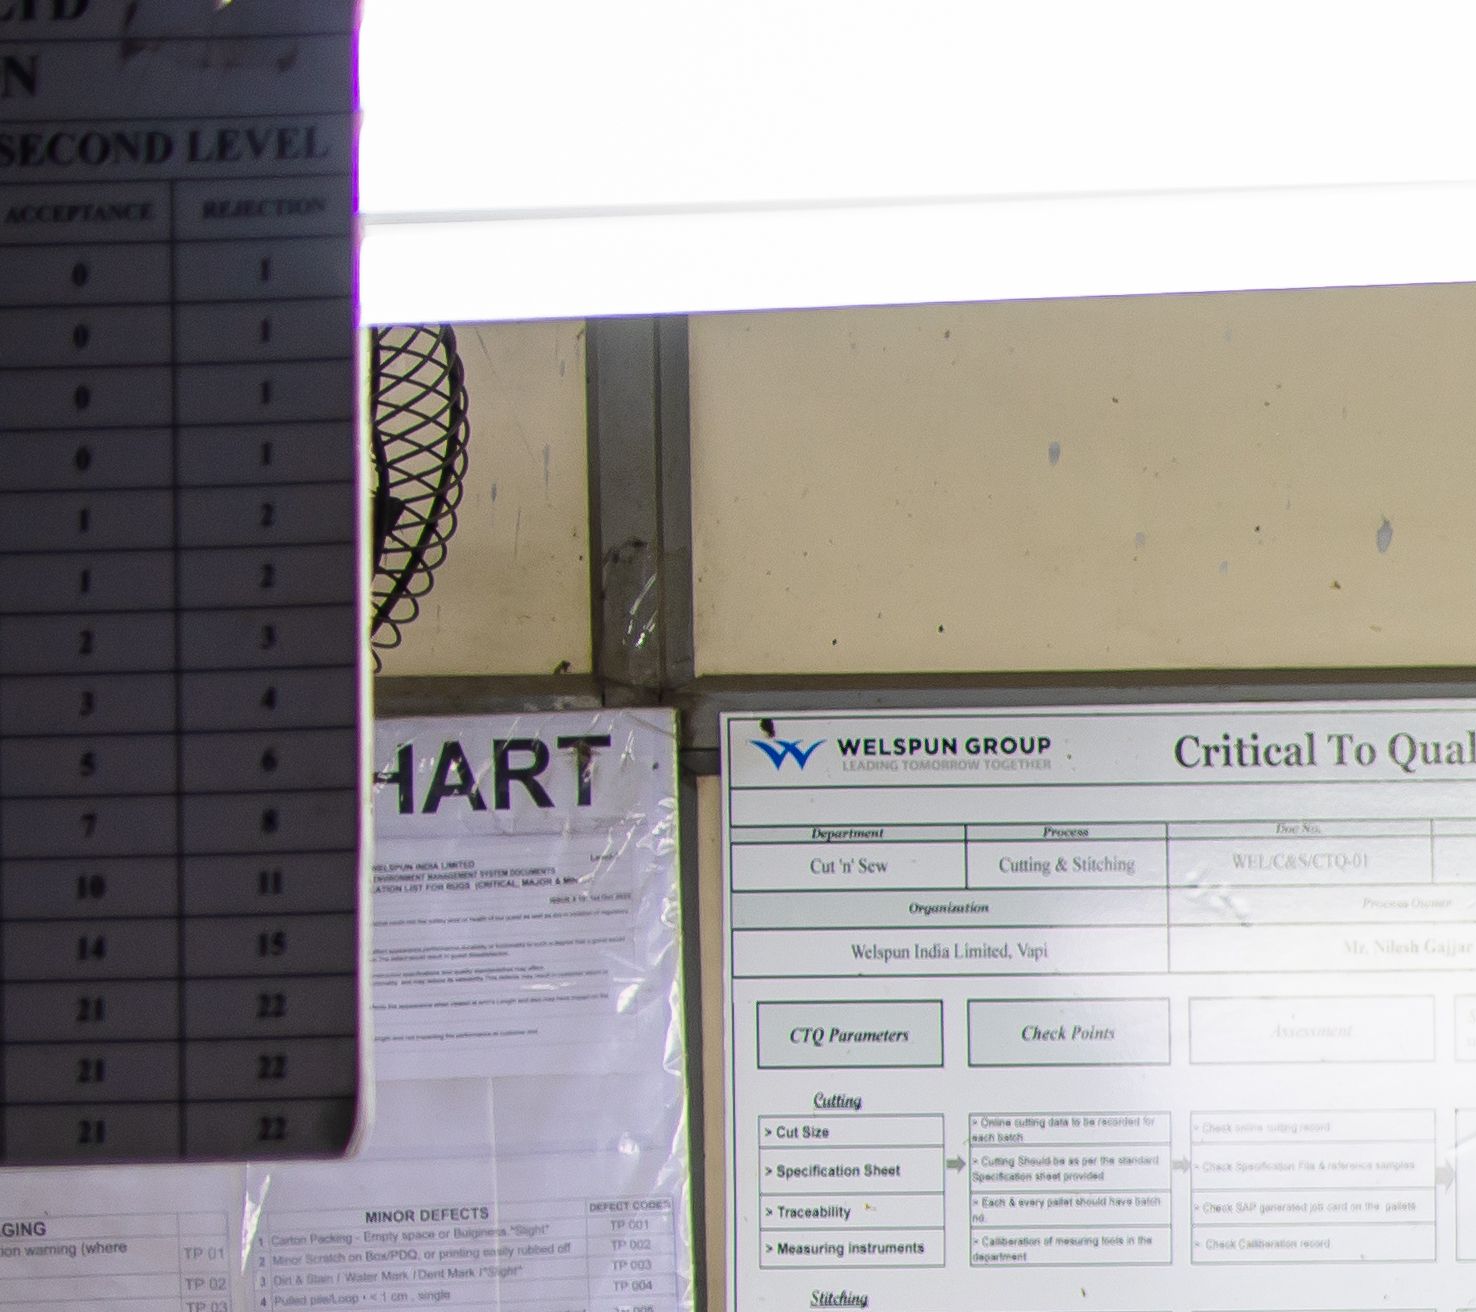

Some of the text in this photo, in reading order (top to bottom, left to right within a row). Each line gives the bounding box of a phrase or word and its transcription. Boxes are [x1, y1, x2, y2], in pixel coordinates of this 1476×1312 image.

[187, 125, 328, 164] LEVEL
[4, 202, 153, 224] ACCEPTANCE
[202, 197, 326, 220] REJECTION
[838, 736, 1051, 756] WELSPUN GROUP
[1175, 730, 1317, 768] Critical
[1327, 733, 1376, 767] To
[843, 758, 1051, 772] LEADING TOMORROW TOGETHER
[811, 828, 884, 842] Department
[810, 859, 834, 874] Cut
[859, 858, 887, 873] Sew
[999, 855, 1134, 877] Cutting & Stitching
[909, 902, 989, 916] Organization
[851, 943, 1048, 962] Welspun India Limited, Vapi
[790, 1027, 909, 1047] CTQ Parameters
[1021, 1024, 1116, 1041] Check Points
[813, 1092, 863, 1110] Cutting
[776, 1125, 830, 1138] Cut Size
[776, 1163, 900, 1180] Specification Sheet
[365, 1206, 489, 1224] MINOR DEFECTS
[777, 1205, 851, 1221] Traceability
[777, 1241, 925, 1258] Measuring instruments
[810, 1290, 868, 1308] Stitching
